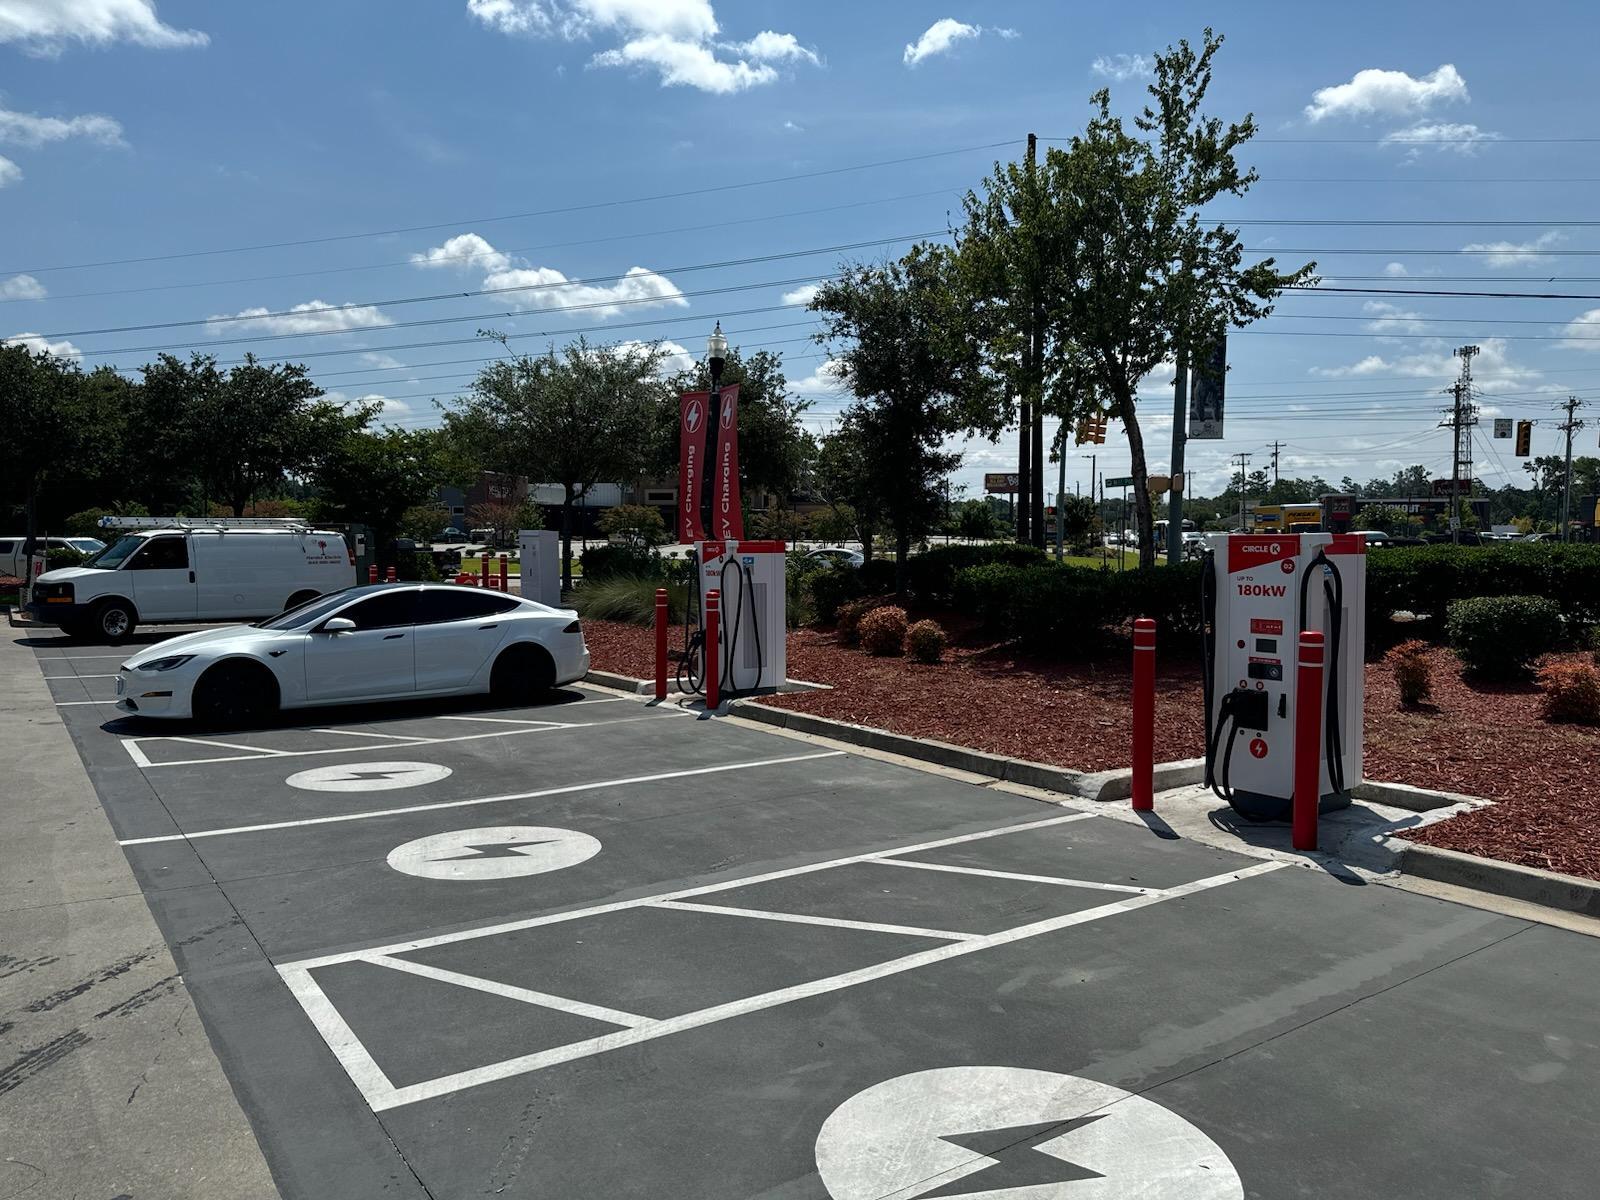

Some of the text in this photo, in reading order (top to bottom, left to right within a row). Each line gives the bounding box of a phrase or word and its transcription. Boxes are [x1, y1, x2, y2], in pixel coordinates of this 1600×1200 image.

[685, 445, 695, 538] EV Charging
[721, 442, 732, 540] EV Charging
[1241, 545, 1269, 553] CIRCLE
[1237, 584, 1287, 597] 180kW
